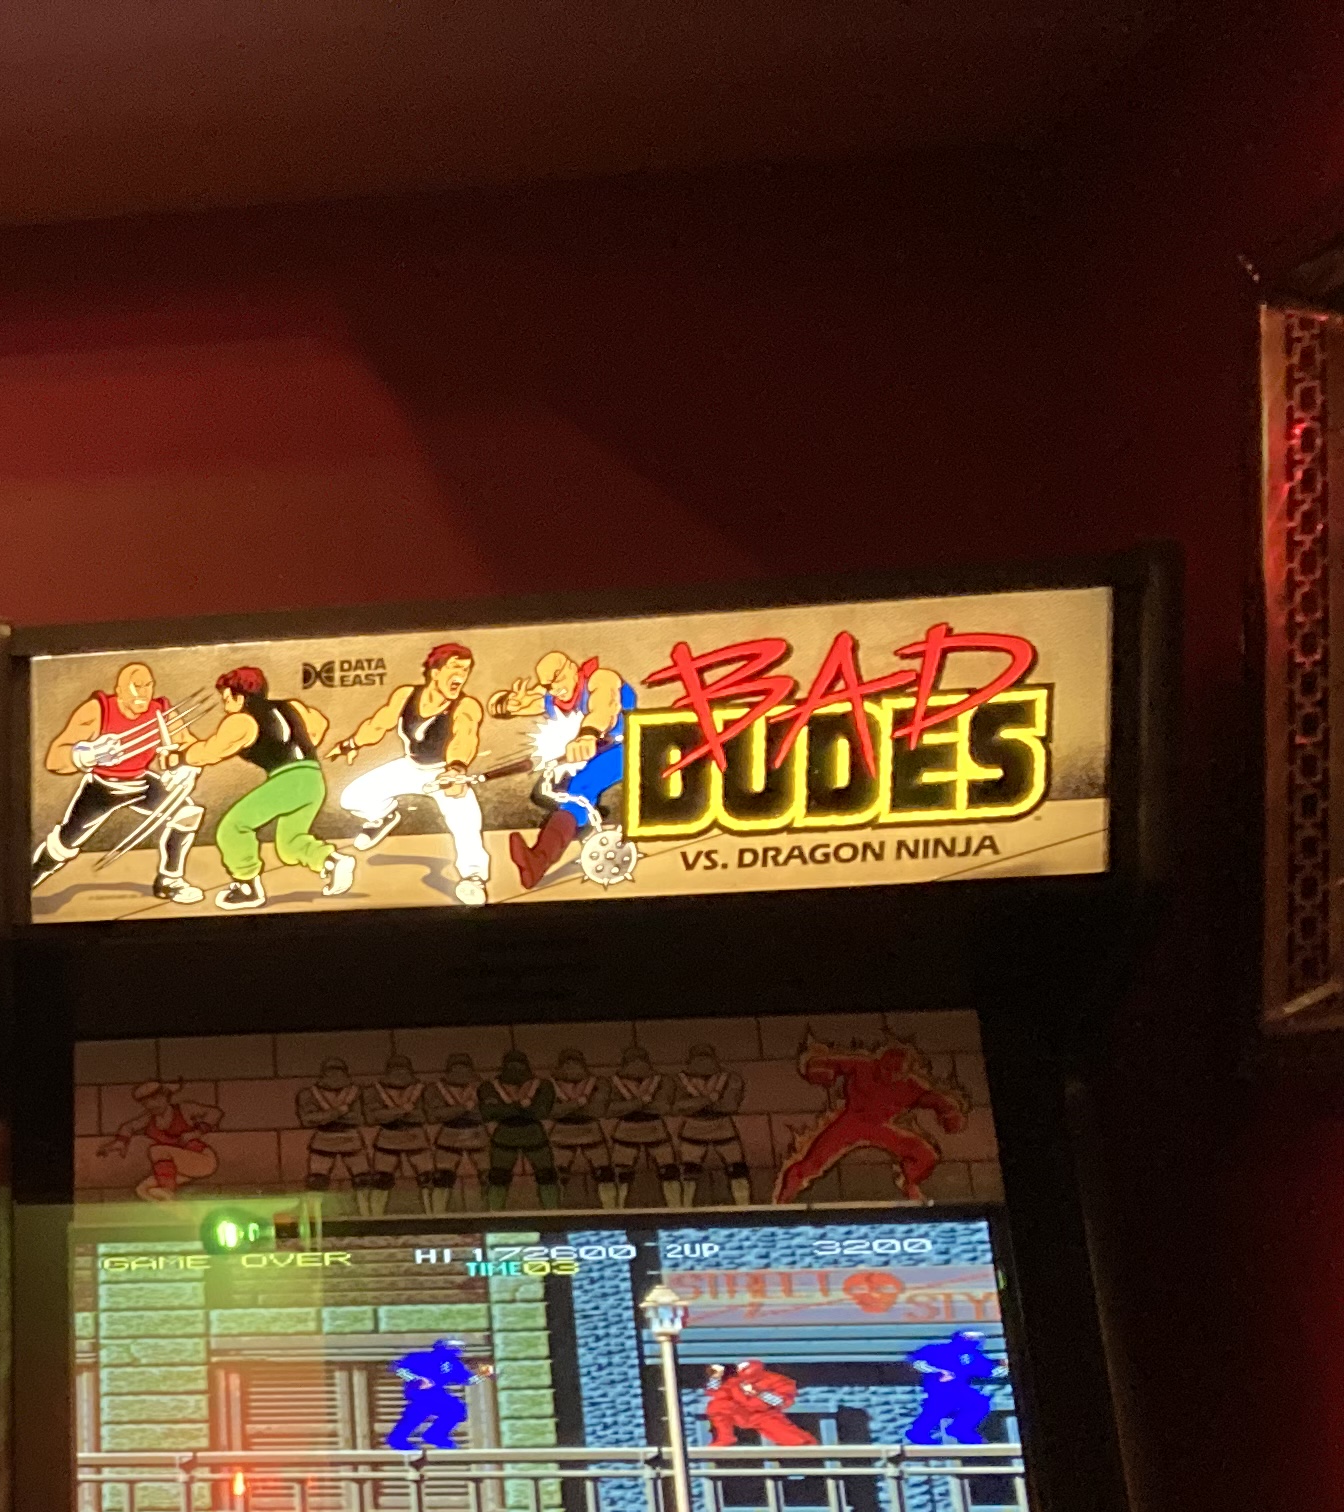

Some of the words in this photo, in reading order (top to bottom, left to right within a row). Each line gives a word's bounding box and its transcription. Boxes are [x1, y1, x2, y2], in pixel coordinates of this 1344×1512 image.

[339, 658, 387, 672] DATA
[339, 672, 387, 687] EAST
[641, 622, 1038, 780] BAD
[625, 684, 1053, 838] DUDES
[680, 848, 728, 871] VS.
[736, 840, 886, 870] DRAGON
[894, 834, 1000, 862] NINJA
[666, 1244, 719, 1258] 2UP
[814, 1239, 933, 1255] 3200
[102, 1255, 212, 1271] GAME
[241, 1251, 351, 1268] OVER
[414, 1249, 451, 1264] HI
